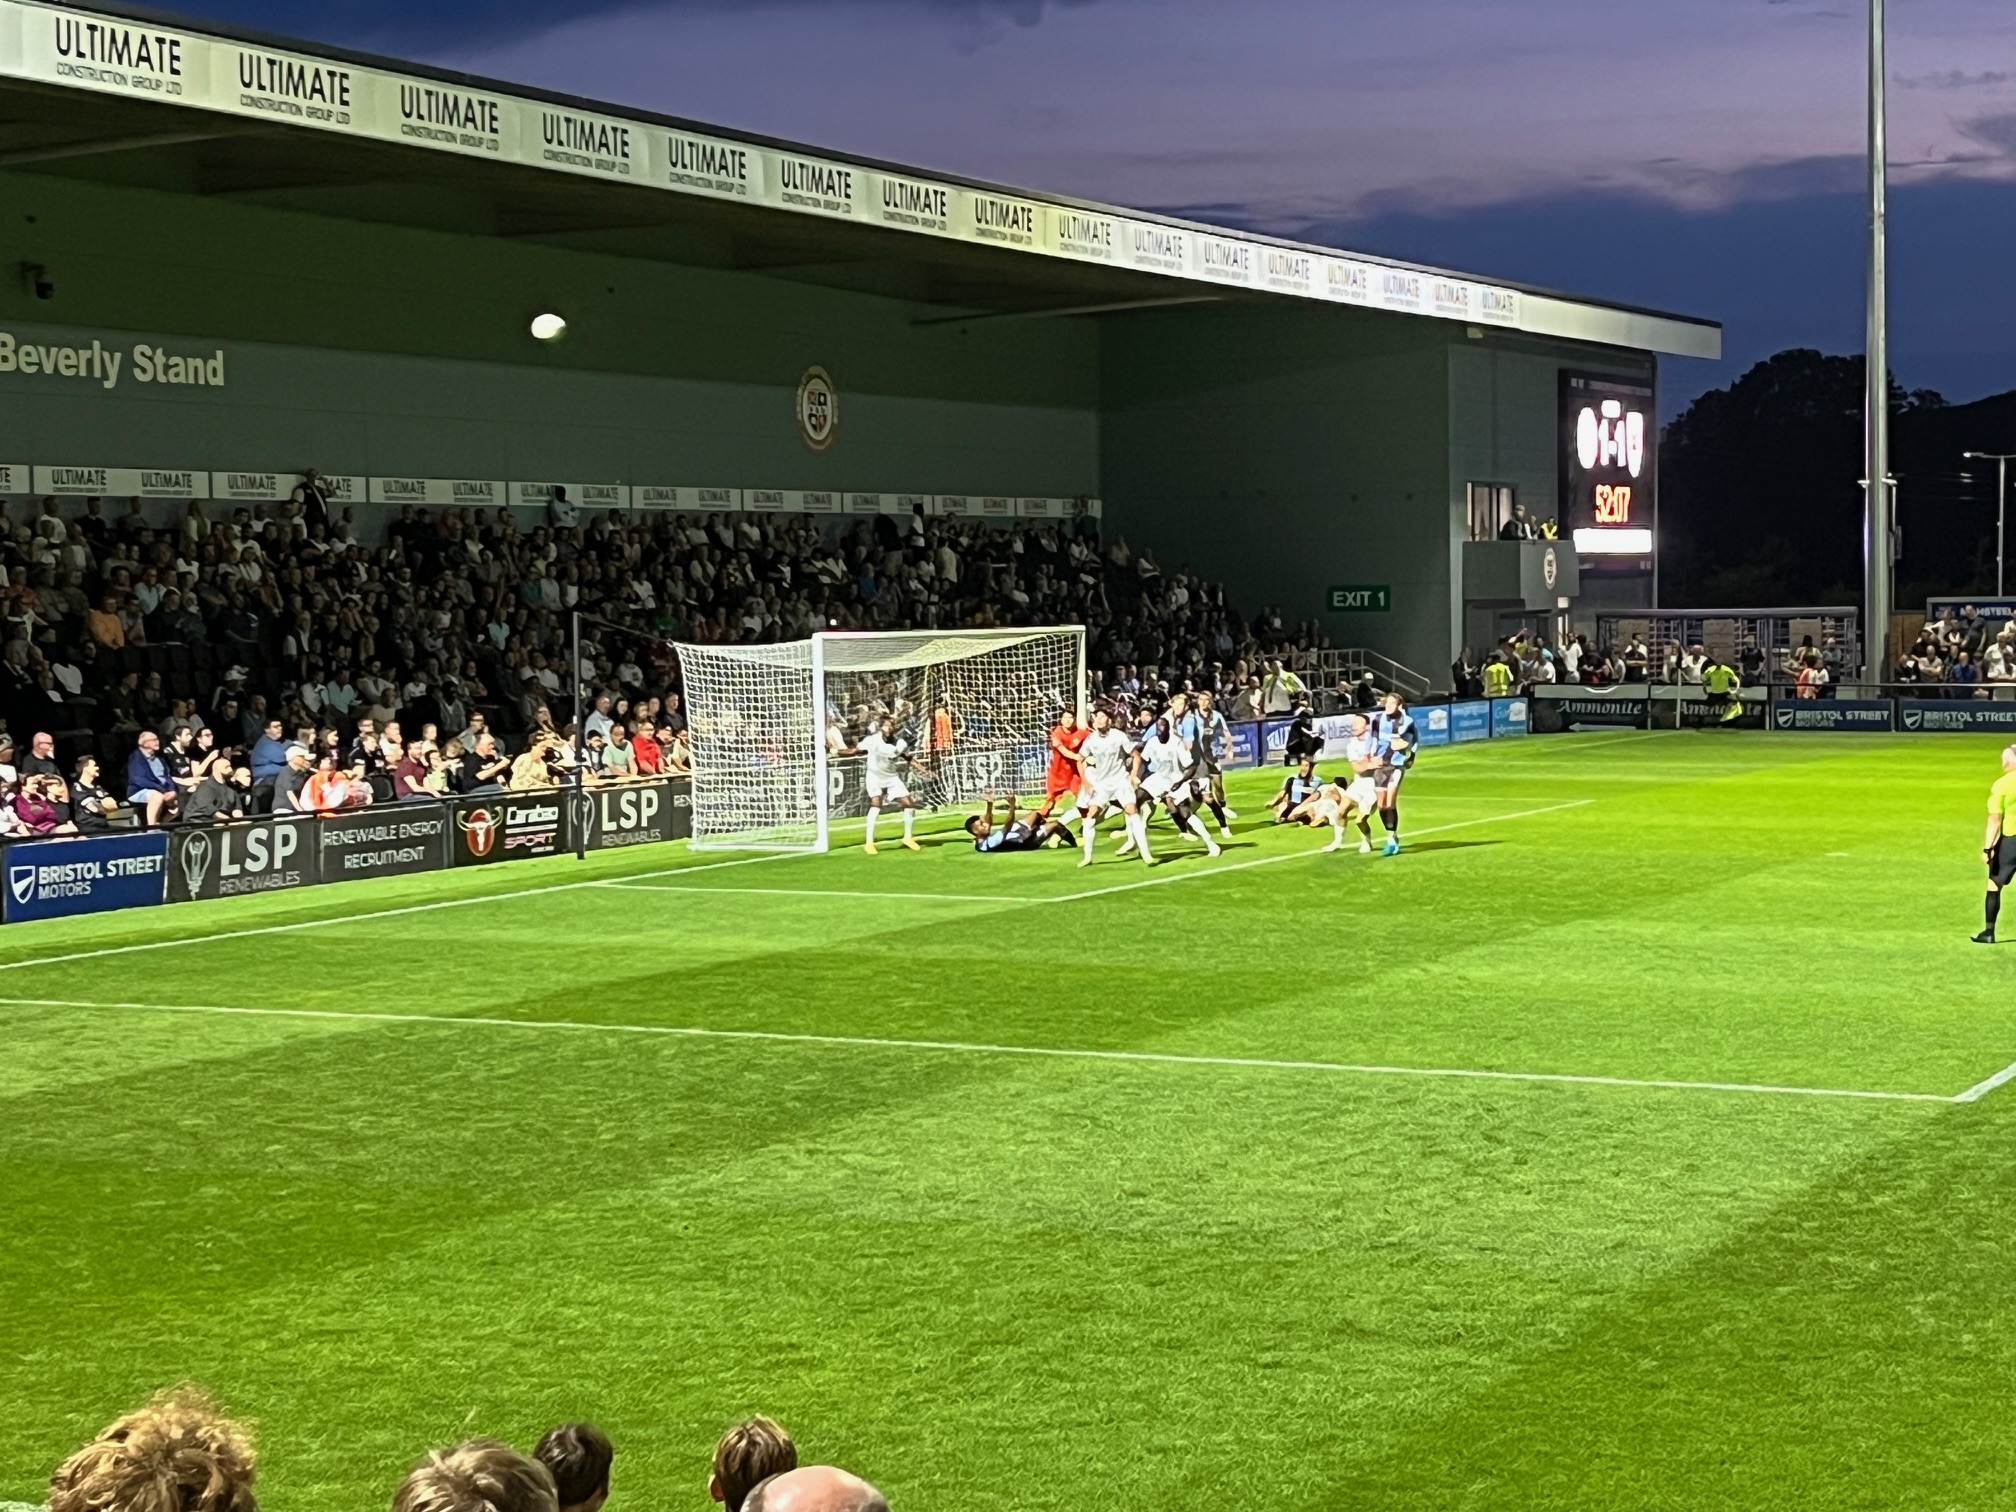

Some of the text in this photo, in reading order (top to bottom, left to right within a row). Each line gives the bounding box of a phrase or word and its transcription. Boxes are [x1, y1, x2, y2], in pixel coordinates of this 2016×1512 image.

[56, 17, 181, 76] ULTIMATE
[239, 52, 350, 106] ULTIMATE
[401, 85, 499, 134] ULTIMATE
[543, 112, 630, 158] ULTIMATE
[668, 137, 746, 180] ULTIMATE
[782, 159, 851, 200] ULTIMATE
[883, 179, 947, 217] ULTIMATE
[975, 198, 1032, 232] ULTIMATE
[1059, 213, 1111, 246] ULTIMATE
[1135, 228, 1182, 258] ULTIMATE
[1204, 241, 1249, 270] ULTIMATE
[1268, 253, 1310, 280] ULTIMATE
[1328, 263, 1367, 289] ULTIMATE
[1383, 274, 1420, 298] ULTIMATE
[0, 332, 225, 389] Beverly Stand
[52, 469, 107, 486] ULTIMATE
[141, 472, 193, 489] ULTIMATE
[227, 474, 276, 491] ULTIMATE
[1333, 591, 1385, 607] EXIT 1
[1556, 700, 1642, 715] Ammonite
[1795, 710, 1889, 721] BRISTOL STREET
[1924, 710, 1973, 722] BRISTOL
[601, 789, 659, 831] LSP
[323, 820, 444, 846] RENEWABLE ENERGY
[504, 832, 557, 849] SPORT
[220, 824, 298, 876] LSP
[344, 846, 425, 869] RECRUITMENT
[38, 855, 163, 884] BRISTOL STREET
[219, 870, 300, 895] RENEWABLES
[38, 881, 92, 900] MOTORS
